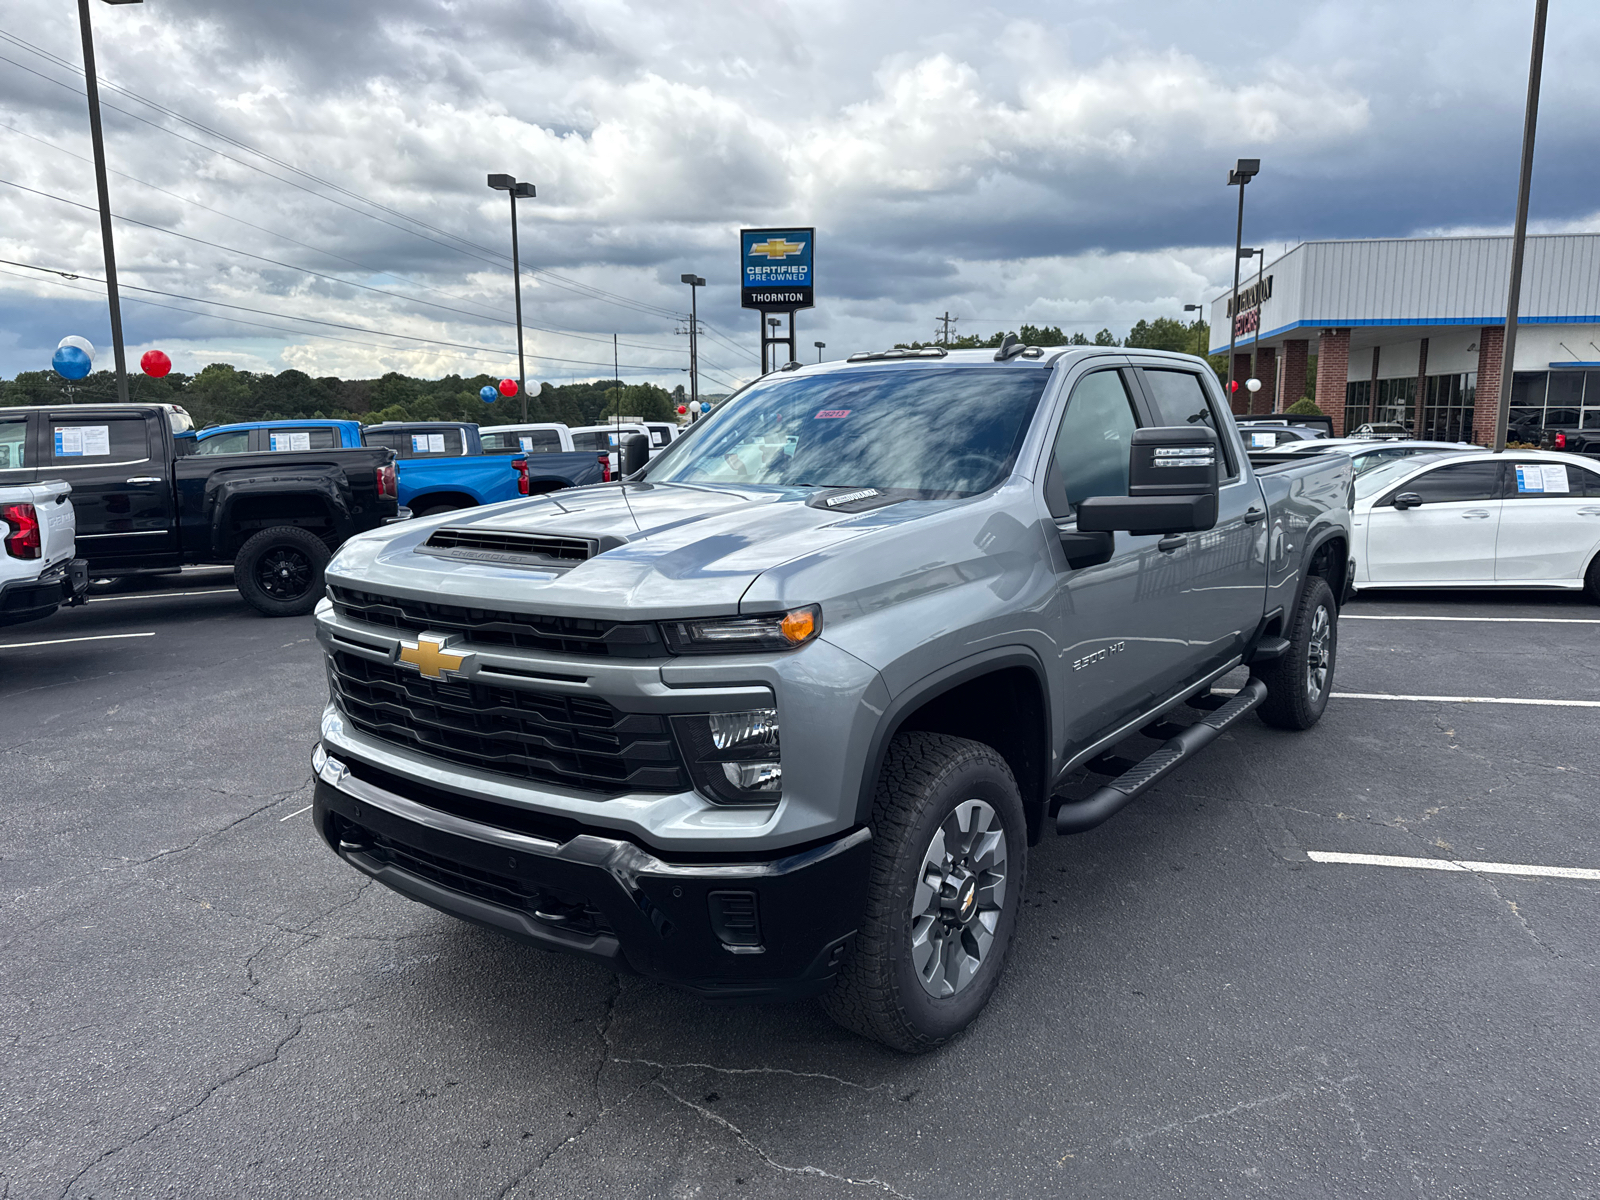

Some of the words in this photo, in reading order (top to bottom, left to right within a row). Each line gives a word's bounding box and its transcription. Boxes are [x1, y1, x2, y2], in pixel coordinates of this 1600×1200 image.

[746, 265, 808, 275] CERTIFIED
[749, 273, 805, 281] PRE-OWNED
[751, 292, 803, 302] THORNTON
[451, 550, 528, 562] CHEVROLET
[1108, 641, 1125, 656] HD
